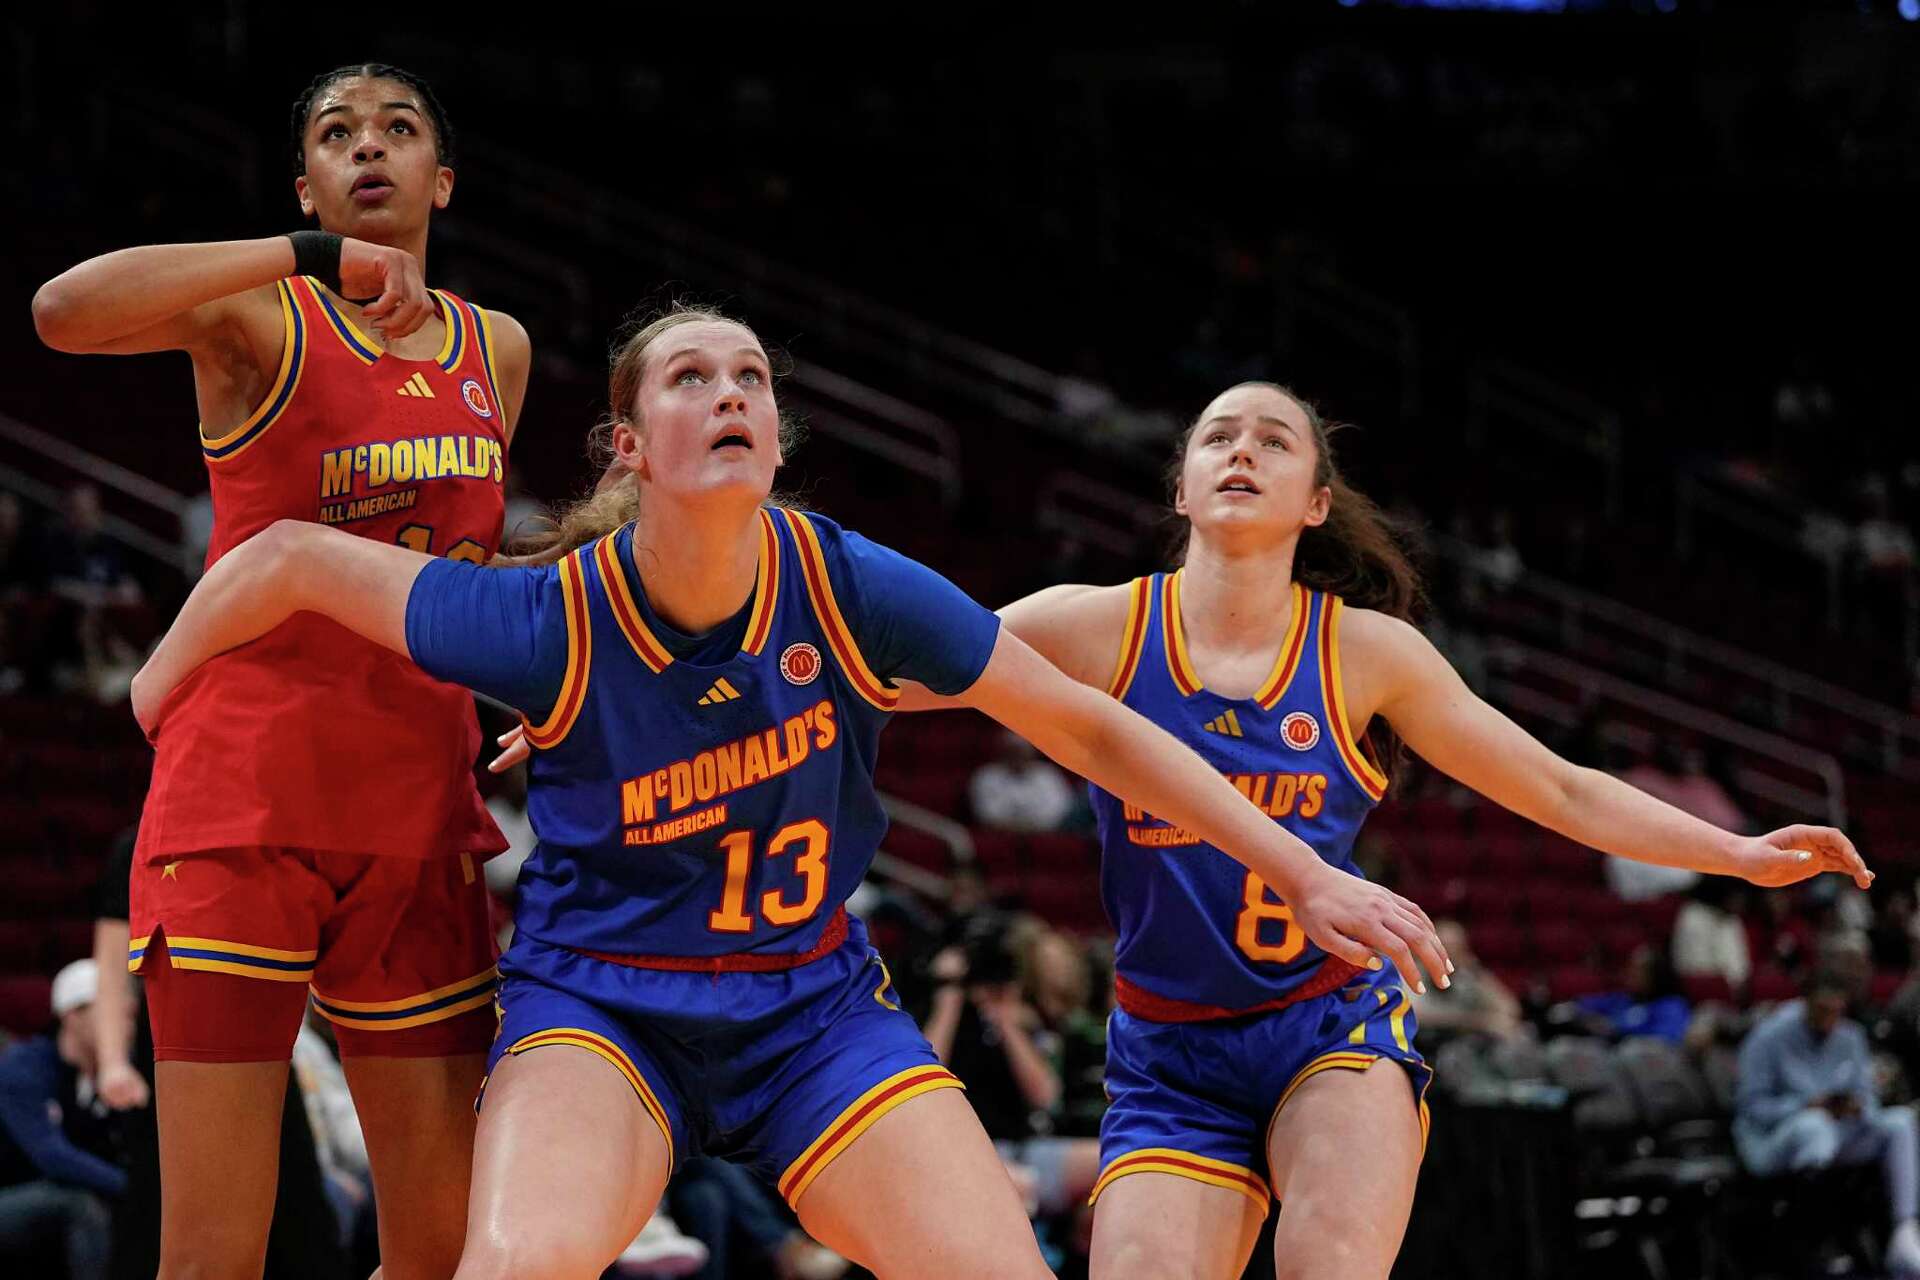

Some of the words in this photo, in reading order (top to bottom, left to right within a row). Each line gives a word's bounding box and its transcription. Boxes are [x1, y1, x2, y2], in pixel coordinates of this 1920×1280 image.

[320, 435, 504, 498] McDONALD'S
[319, 505, 345, 523] ALL
[347, 490, 417, 519] AMERICAN
[621, 699, 838, 825] McDONALD'S
[623, 827, 651, 846] ALL
[651, 804, 727, 844] AMERICAN
[709, 818, 831, 934] 13
[1235, 870, 1308, 965] 8
